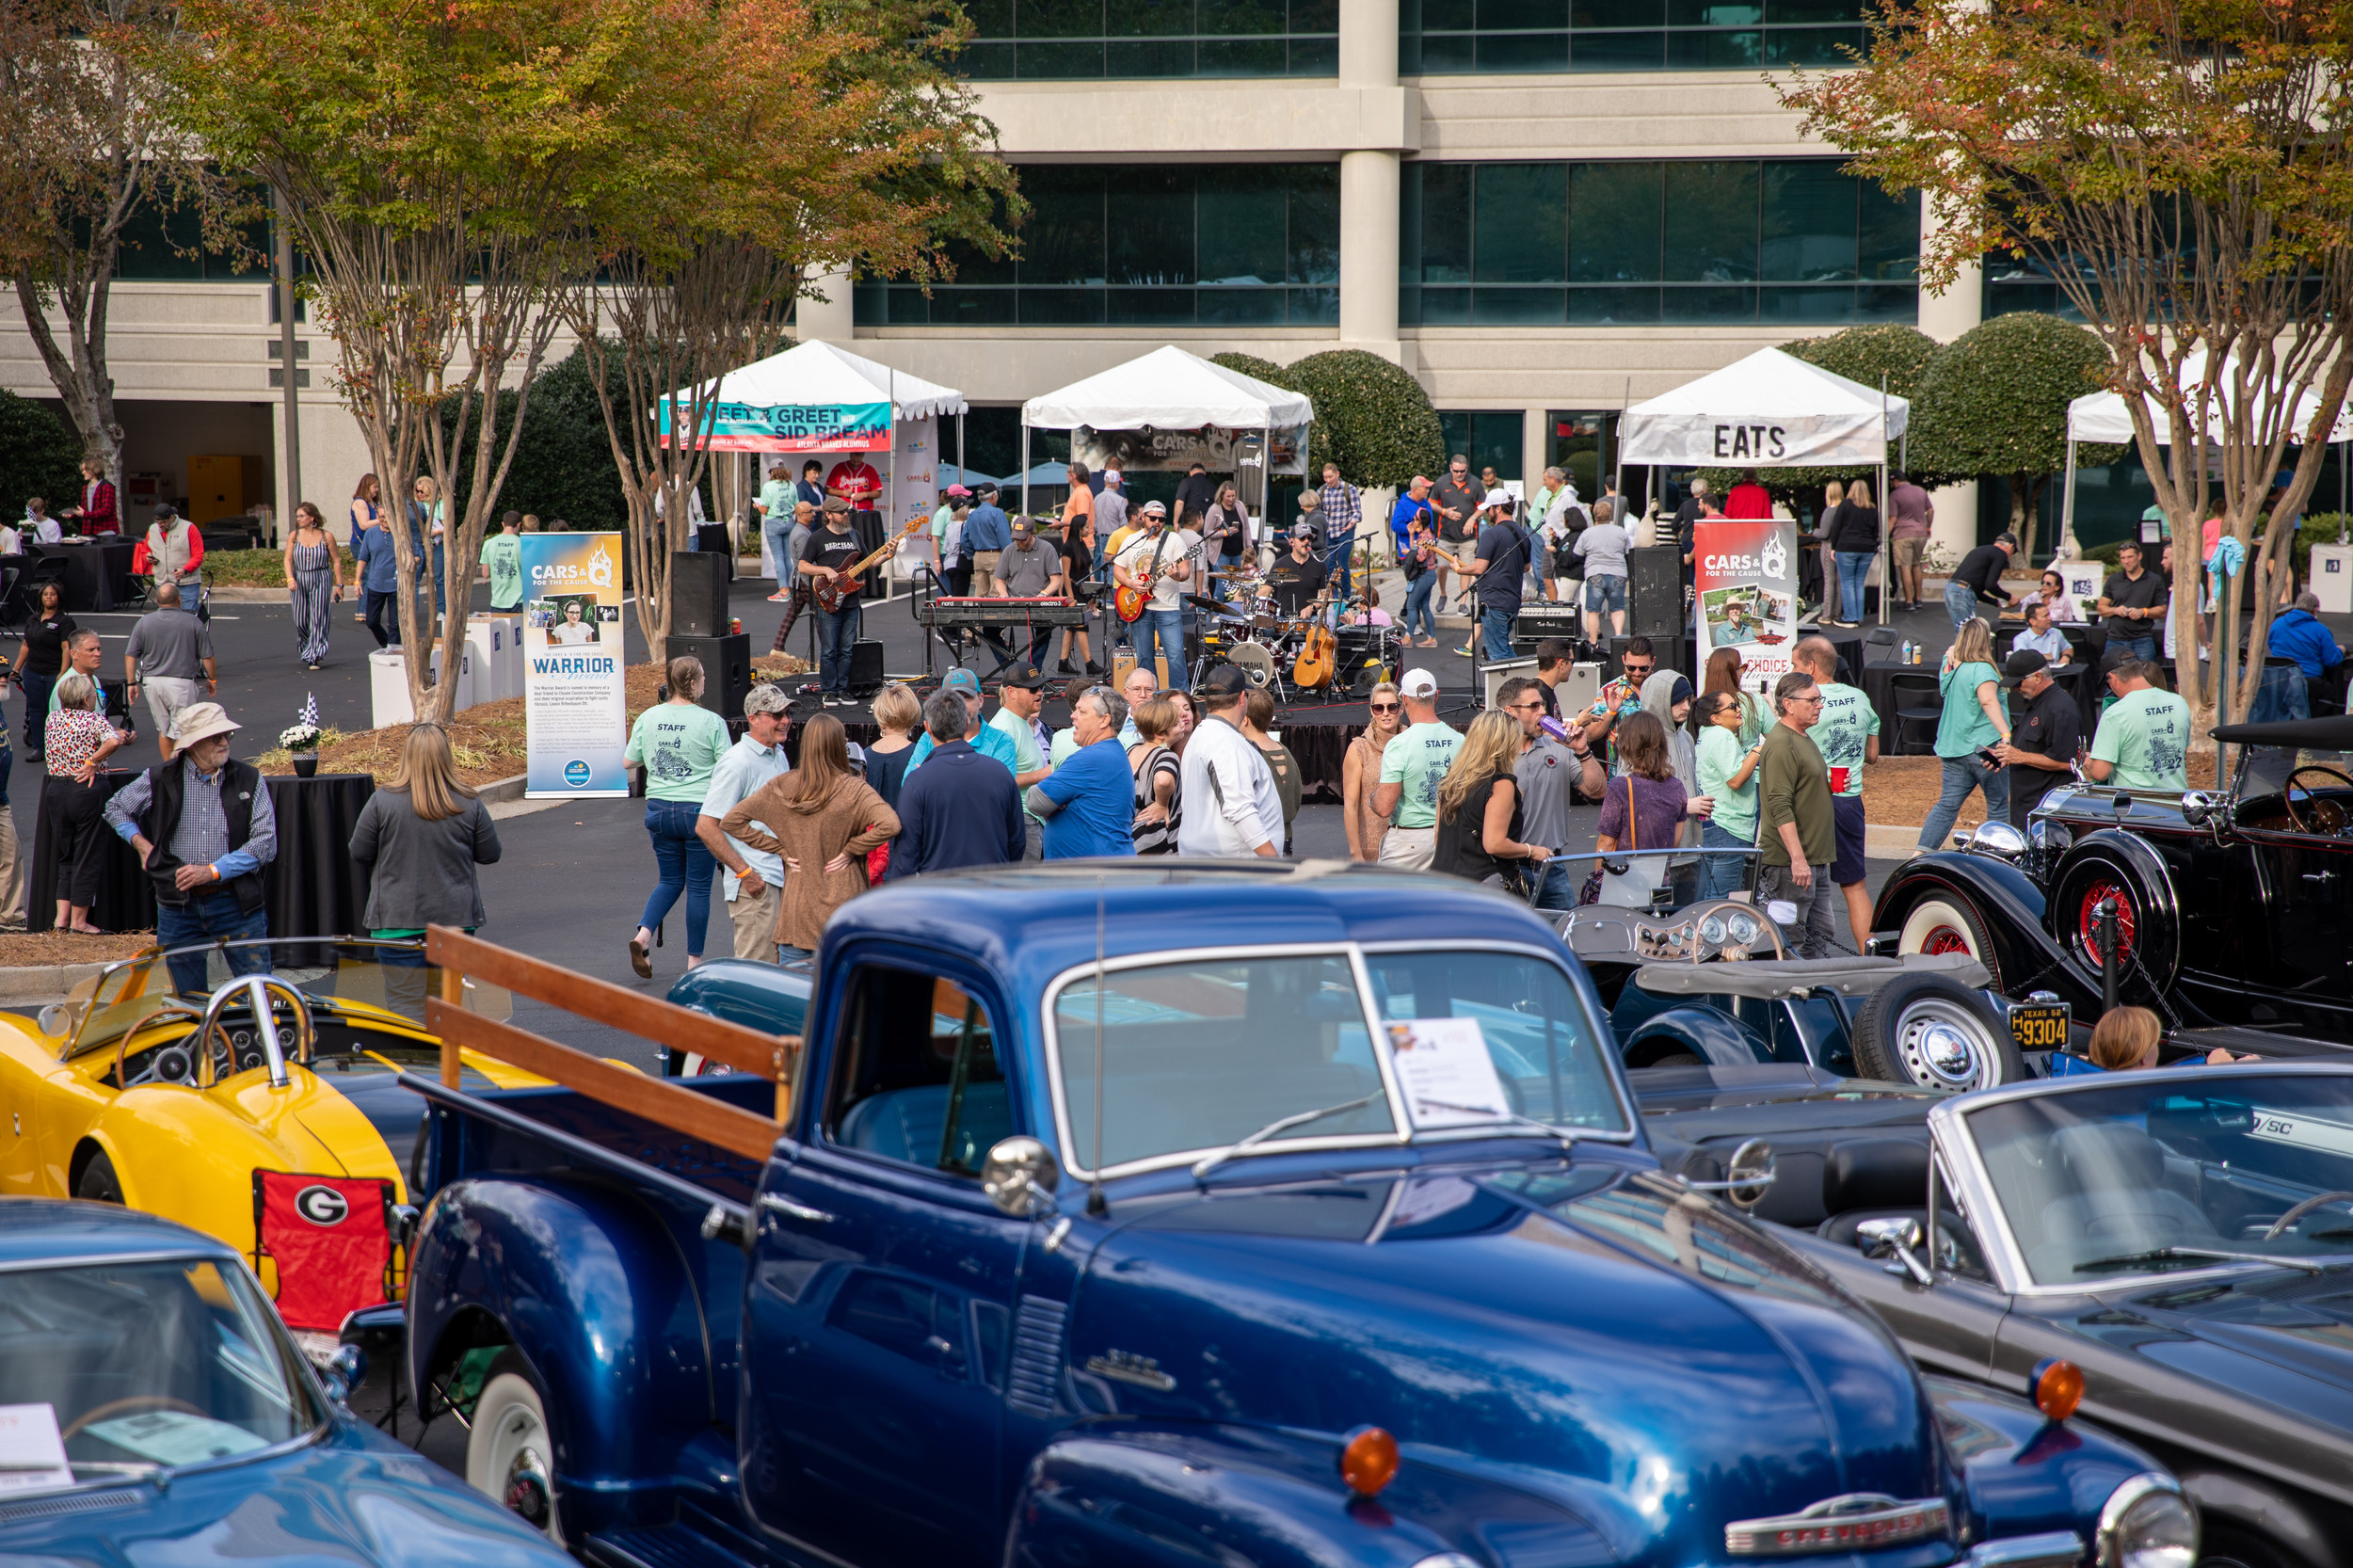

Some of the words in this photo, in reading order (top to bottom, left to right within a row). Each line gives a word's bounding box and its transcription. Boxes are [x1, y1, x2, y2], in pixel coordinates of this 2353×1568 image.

[760, 408, 772, 423] &
[777, 408, 841, 424] GREET
[775, 425, 808, 440] SID
[815, 424, 887, 440] BREAM
[796, 440, 821, 449] ATLANTA
[822, 440, 842, 449] BRAVES
[842, 440, 870, 449] ALUMNUS
[1152, 435, 1196, 450] CARS
[1714, 424, 1785, 458] EATS
[1704, 554, 1751, 570] CARS
[1753, 558, 1760, 568] &
[1762, 537, 1787, 580] Q
[531, 565, 578, 579] CARS
[579, 568, 587, 577] &
[588, 548, 613, 587] Q
[533, 657, 614, 674] WARRIOR
[1747, 659, 1787, 672] CHOICE
[1827, 696, 1855, 708] STAFF
[2145, 705, 2173, 715] STAFF
[1425, 739, 1452, 748] STAFF
[2024, 1018, 2066, 1045] 9304
[301, 1188, 346, 1224] G
[1777, 1513, 1925, 1546] CHEVROLET
